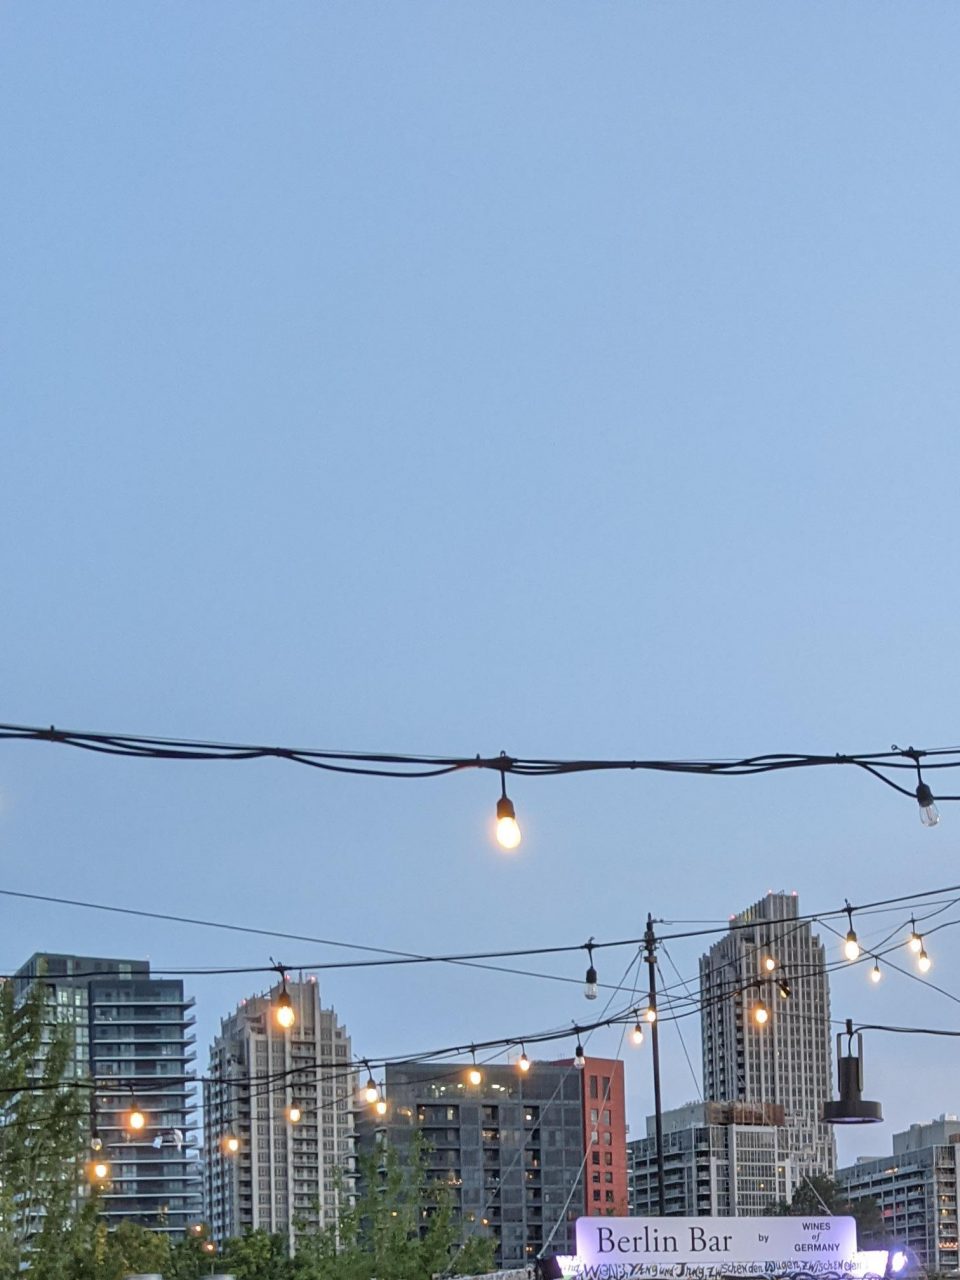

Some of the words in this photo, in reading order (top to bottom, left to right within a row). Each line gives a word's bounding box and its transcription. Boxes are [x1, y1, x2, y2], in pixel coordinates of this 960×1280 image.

[802, 1222, 831, 1231] WINES
[597, 1226, 679, 1254] Berlin
[689, 1227, 733, 1253] Bar
[758, 1233, 769, 1244] by
[812, 1231, 820, 1242] of
[794, 1242, 840, 1253] GERMANY
